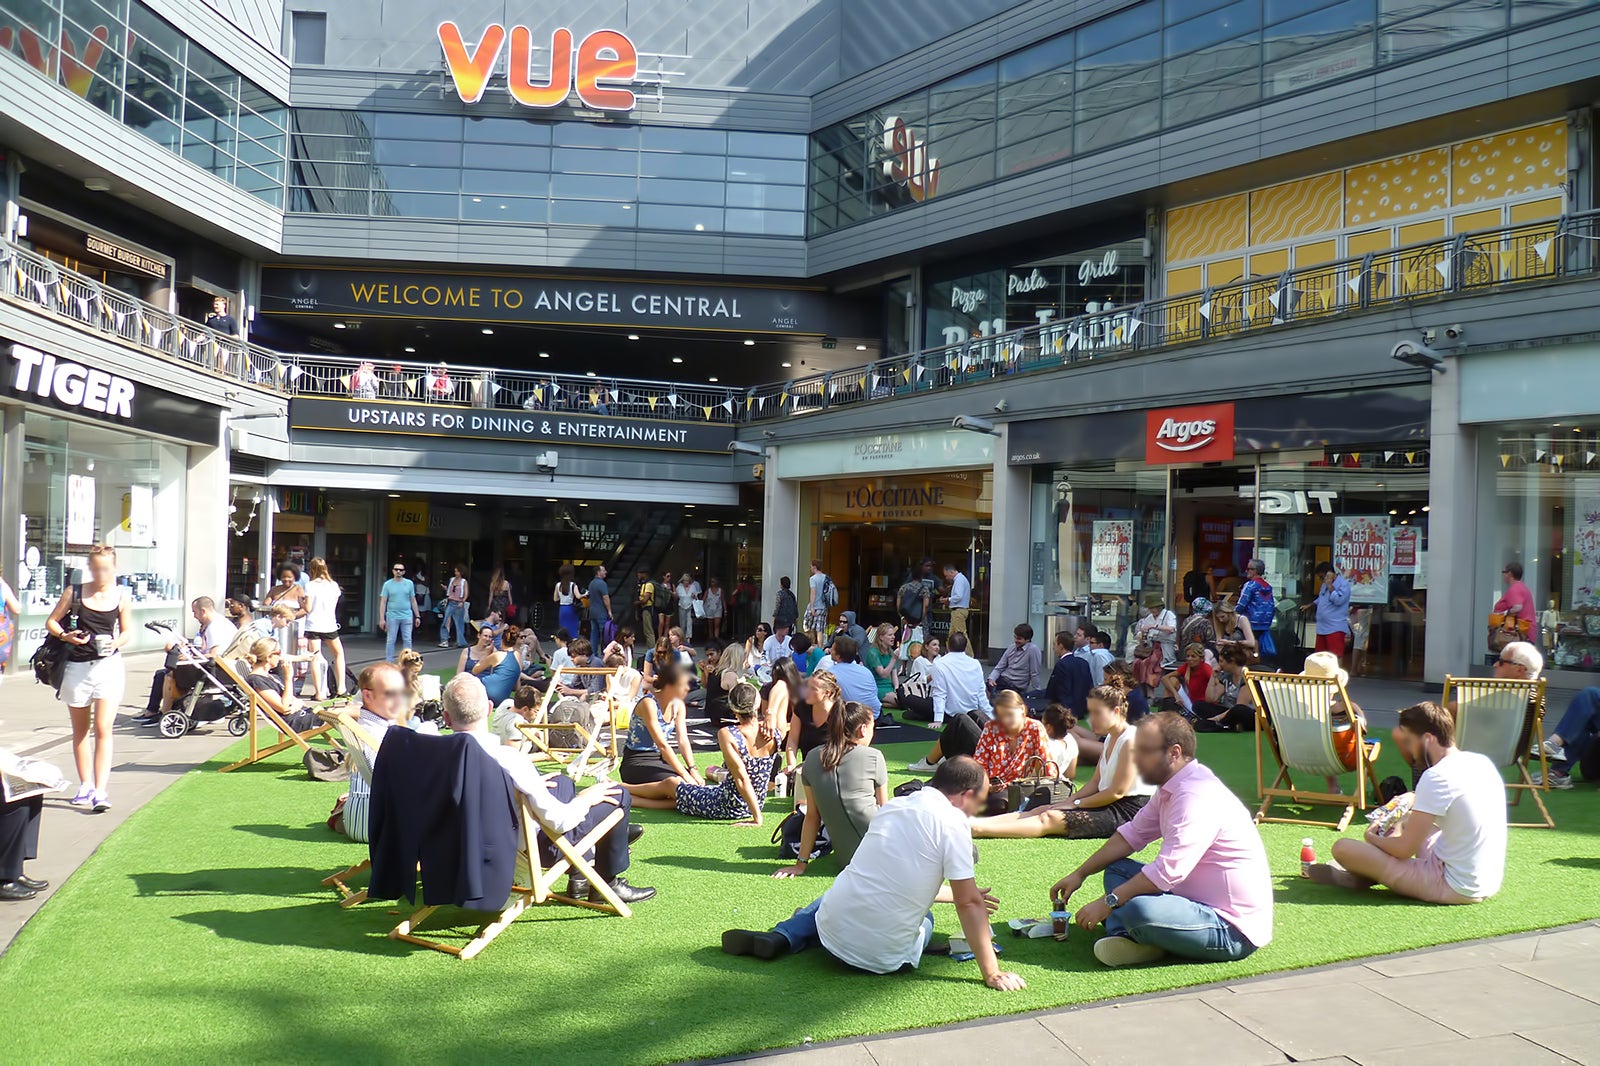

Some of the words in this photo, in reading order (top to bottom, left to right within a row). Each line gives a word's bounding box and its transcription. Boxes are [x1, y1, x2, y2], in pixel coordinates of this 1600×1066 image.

[87, 238, 117, 257] GOURMET
[117, 249, 141, 267] BURGER
[141, 258, 166, 276] KITCHEN
[951, 287, 986, 313] Pizza
[1008, 268, 1048, 296] Pasta
[1078, 250, 1119, 286] Grill
[350, 283, 481, 308] WELCOME
[491, 288, 524, 309] TO
[534, 290, 621, 313] ANGEL
[631, 294, 742, 318] CENTRAL
[11, 344, 136, 418] TIGER
[348, 408, 426, 427] UPSTAIRS
[432, 413, 465, 429] FOR
[471, 416, 535, 434] DINING
[540, 421, 552, 435] &
[558, 422, 688, 443] ENTERTAINMENT
[1156, 418, 1216, 443] Argos
[1011, 452, 1041, 461] argos.co.uk
[846, 487, 945, 508] L'OCCITANE
[1352, 529, 1370, 542] GET
[1335, 543, 1366, 556] READY
[1369, 543, 1387, 556] FOR
[1341, 557, 1381, 571] AUTUMN
[18, 628, 47, 641] TIGE
